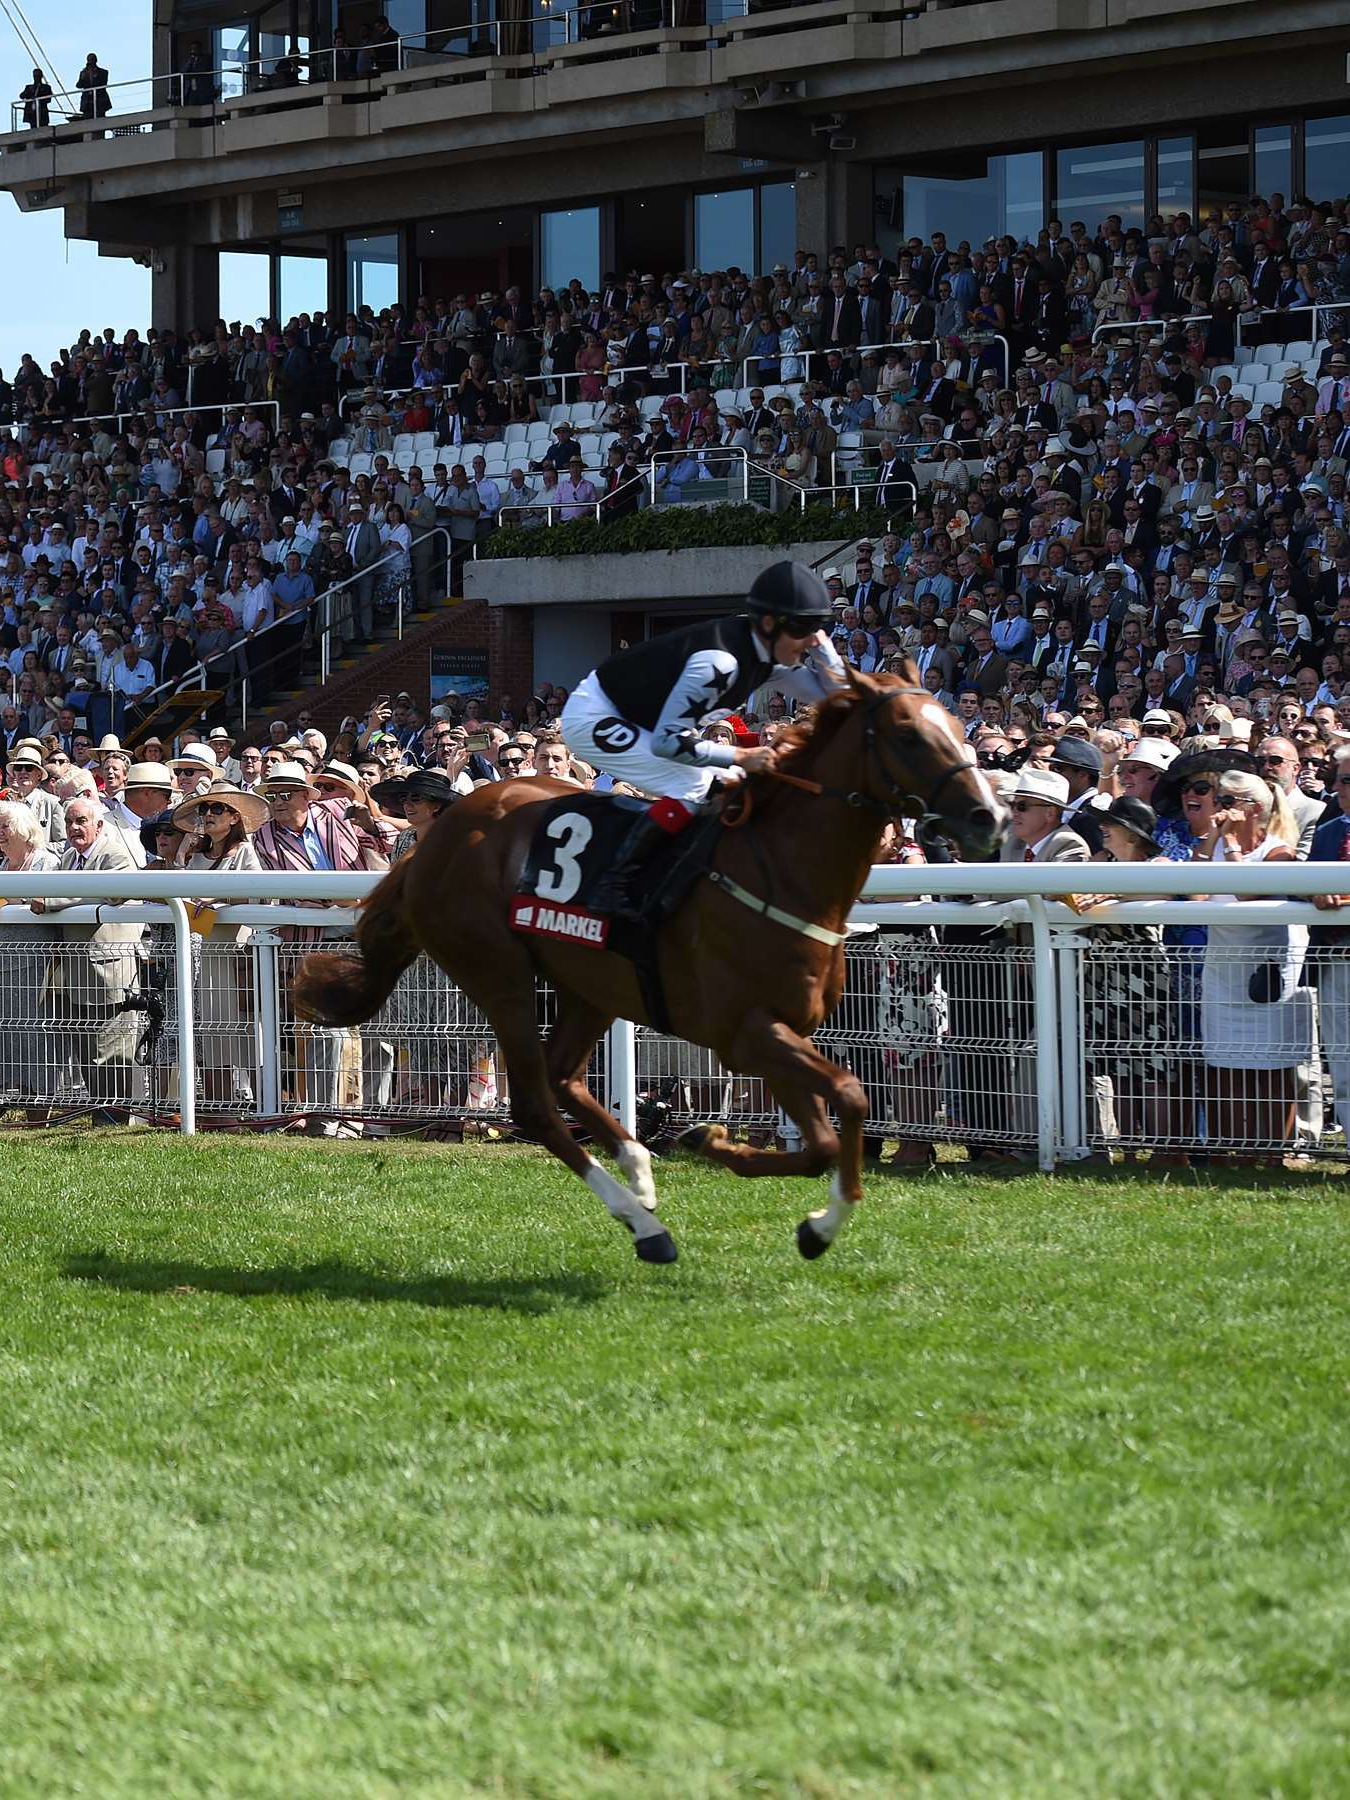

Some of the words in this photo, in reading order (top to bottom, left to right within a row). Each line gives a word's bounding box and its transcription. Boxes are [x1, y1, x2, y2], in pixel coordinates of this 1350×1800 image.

[594, 723, 635, 747] JD
[534, 811, 593, 904] 3
[535, 907, 603, 943] MARKEL
